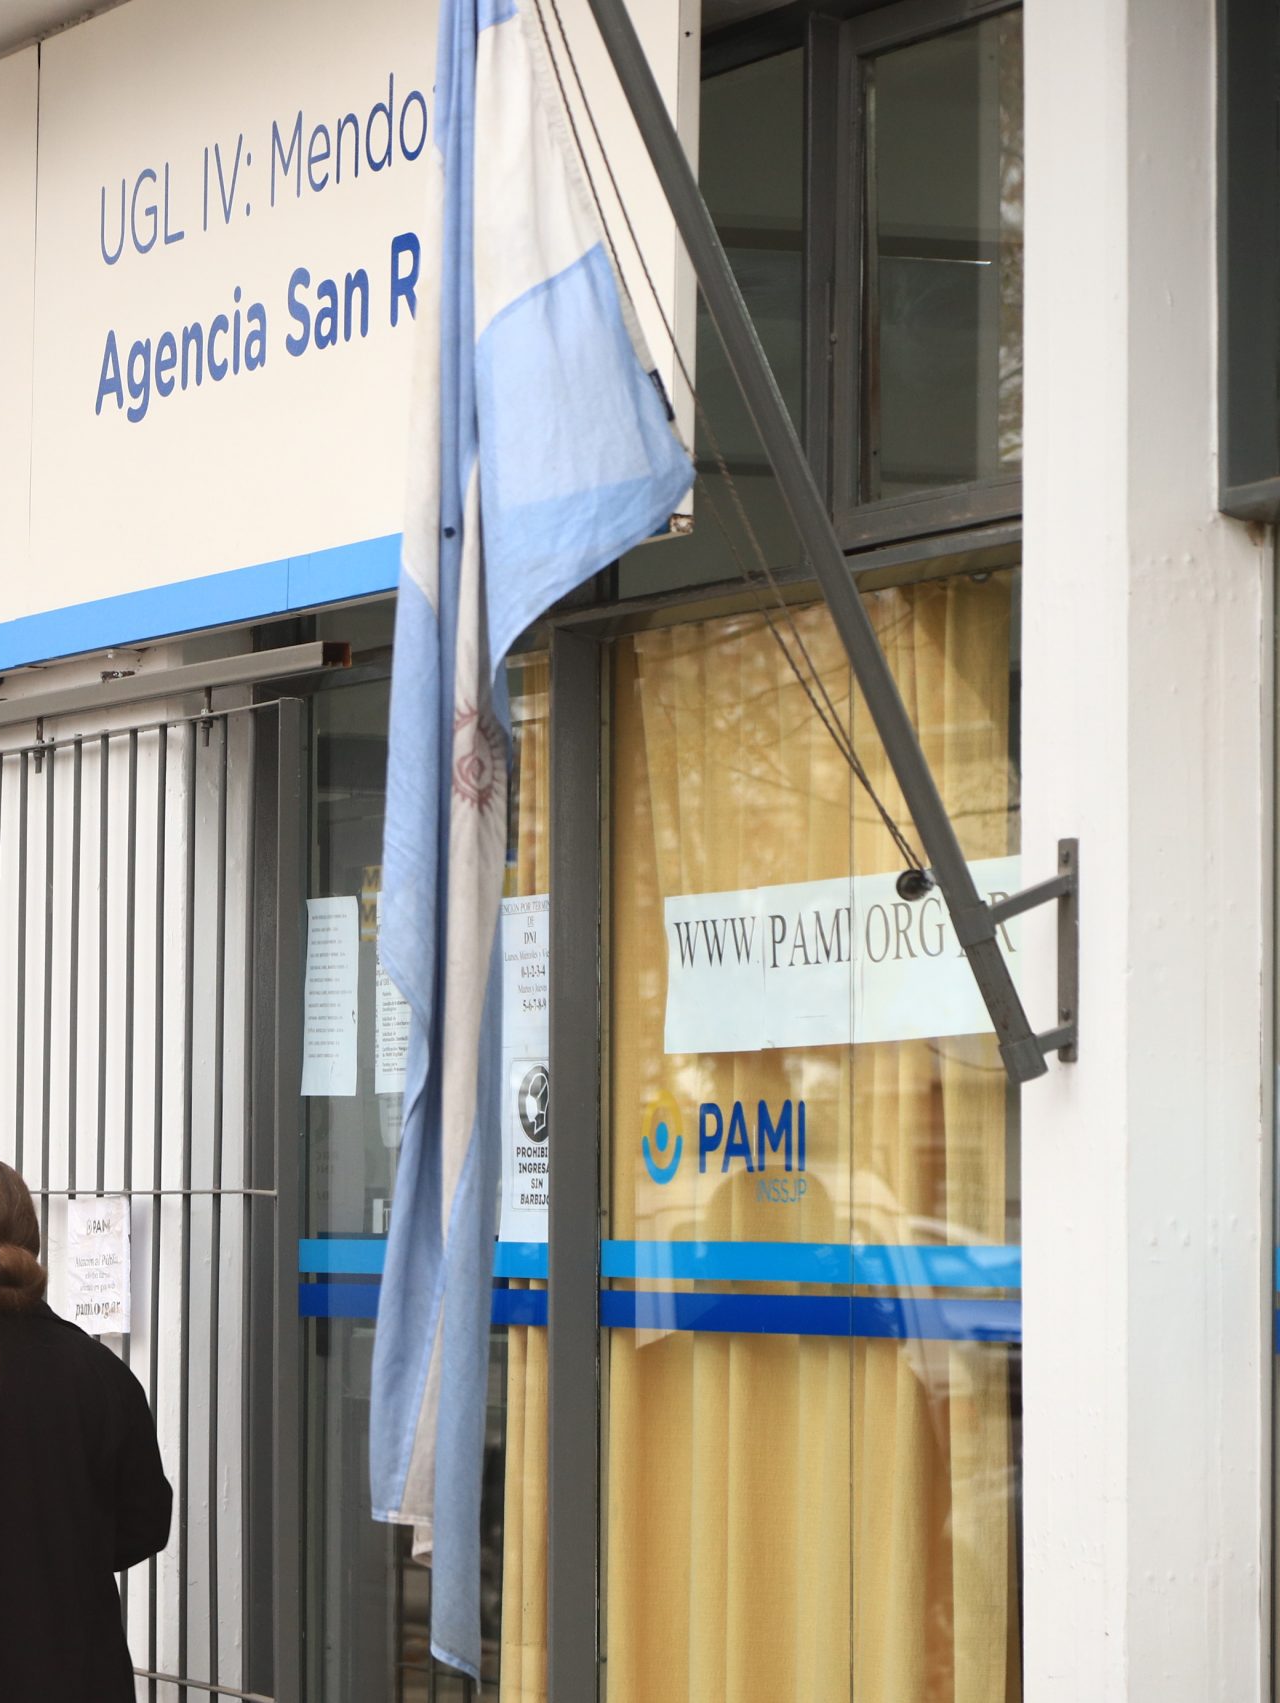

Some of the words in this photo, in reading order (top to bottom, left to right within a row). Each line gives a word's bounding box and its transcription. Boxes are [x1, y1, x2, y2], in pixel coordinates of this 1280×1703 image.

[100, 161, 185, 266] UGL
[203, 132, 252, 232] IV:
[270, 72, 435, 207] Mendo
[95, 285, 267, 424] Agencia
[285, 267, 369, 357] San
[390, 232, 421, 328] R
[524, 932, 537, 944] DNI
[698, 1098, 806, 1174] PAMI
[516, 1146, 549, 1158] PROHIBI
[518, 1162, 549, 1174] INGRESA
[531, 1178, 544, 1189] SIN
